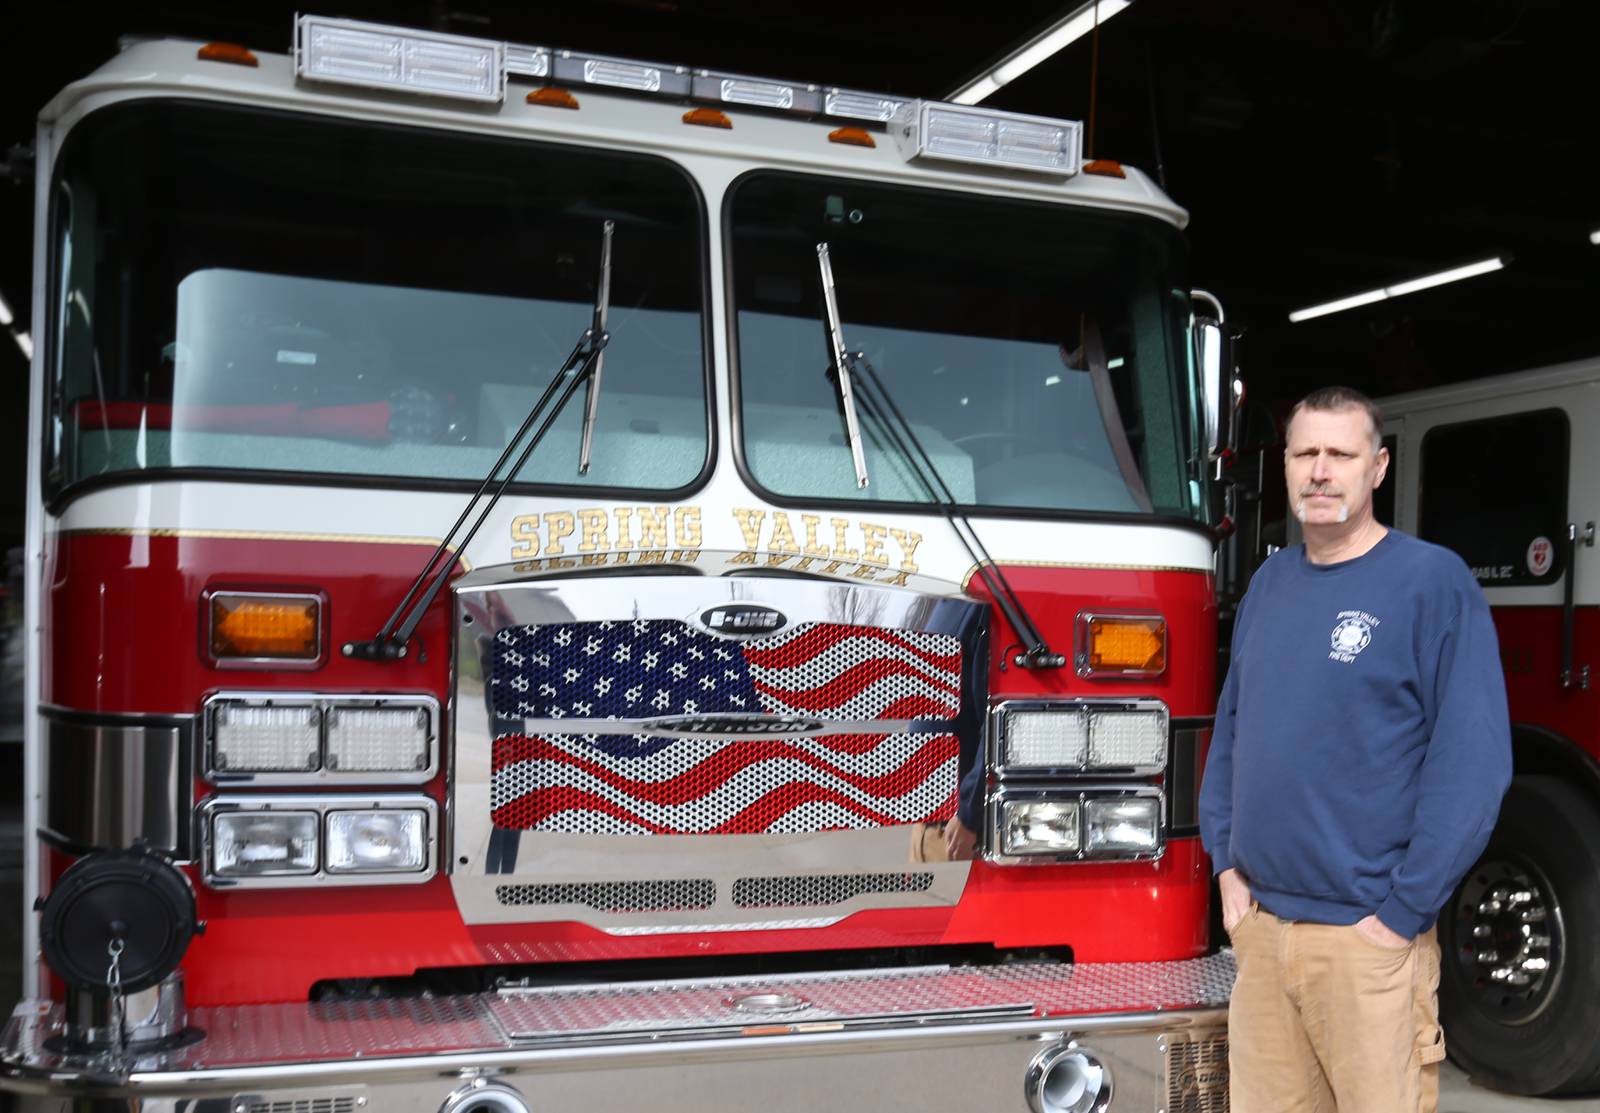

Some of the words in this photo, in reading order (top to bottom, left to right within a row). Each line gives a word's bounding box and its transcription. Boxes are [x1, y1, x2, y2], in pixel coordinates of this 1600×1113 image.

[511, 506, 702, 559] SPRING
[732, 507, 923, 574] VALLEY
[709, 611, 779, 627] E-ONE
